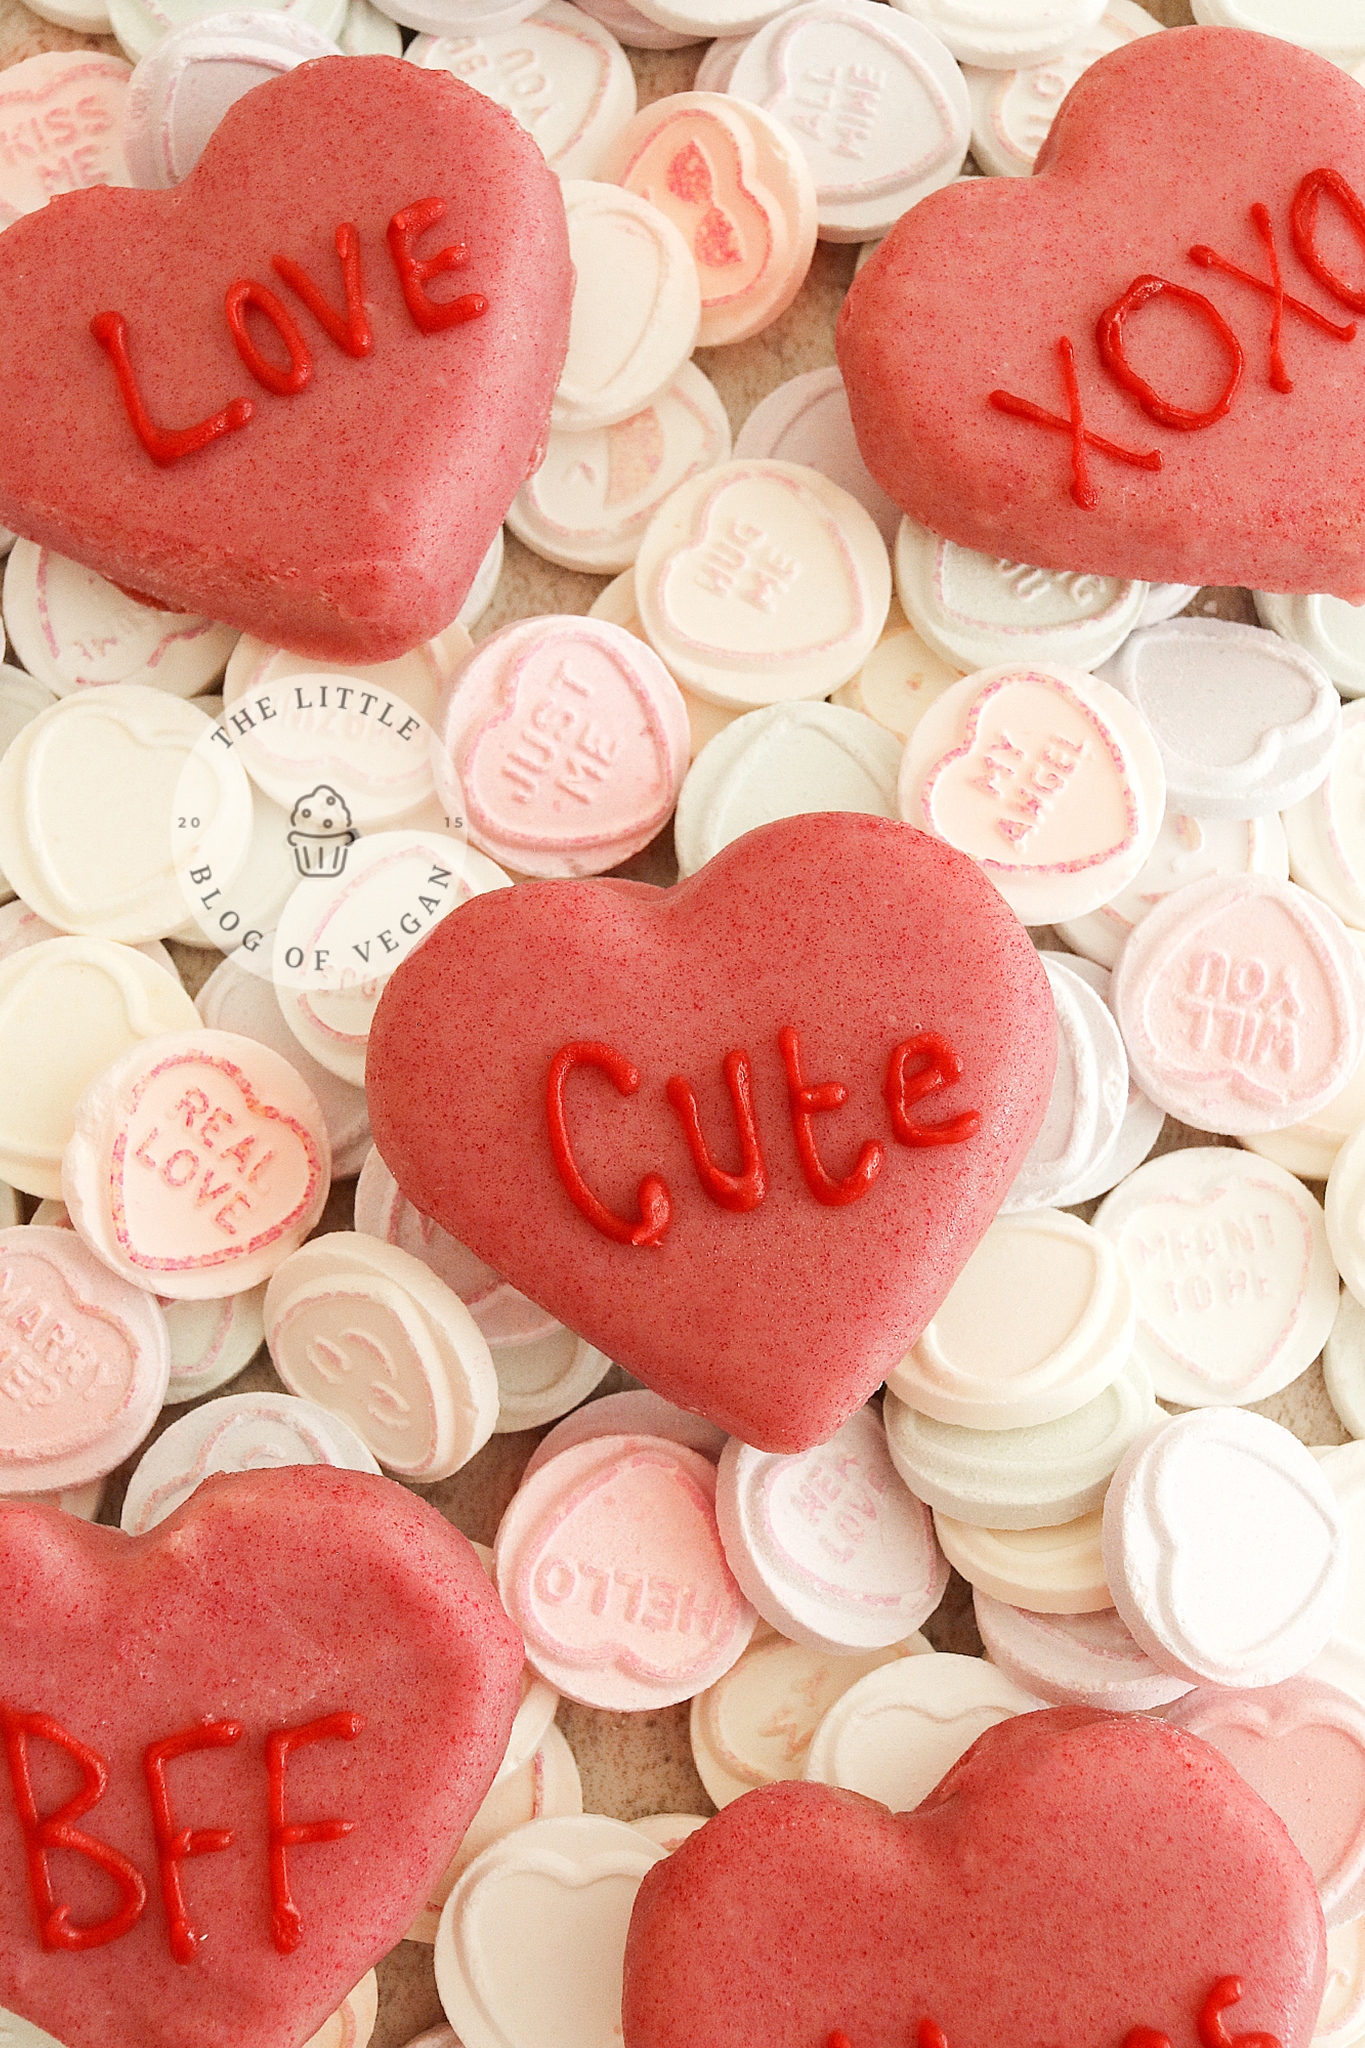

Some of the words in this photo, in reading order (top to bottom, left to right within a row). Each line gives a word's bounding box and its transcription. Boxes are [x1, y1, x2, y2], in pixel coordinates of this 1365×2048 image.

[0, 94, 113, 167] KISS
[36, 144, 109, 192] ME
[89, 196, 489, 469] LOVE
[693, 518, 766, 601] HUG
[736, 546, 799, 616] ME
[500, 659, 592, 807] JUST
[552, 722, 618, 808] ME
[994, 731, 1091, 854] ANGEL
[132, 1126, 253, 1238] LOVE
[168, 1086, 275, 1197] REAL
[546, 1025, 983, 1249] Cute
[532, 1554, 723, 1642] HELLO
[0, 1705, 366, 1965] BFF
